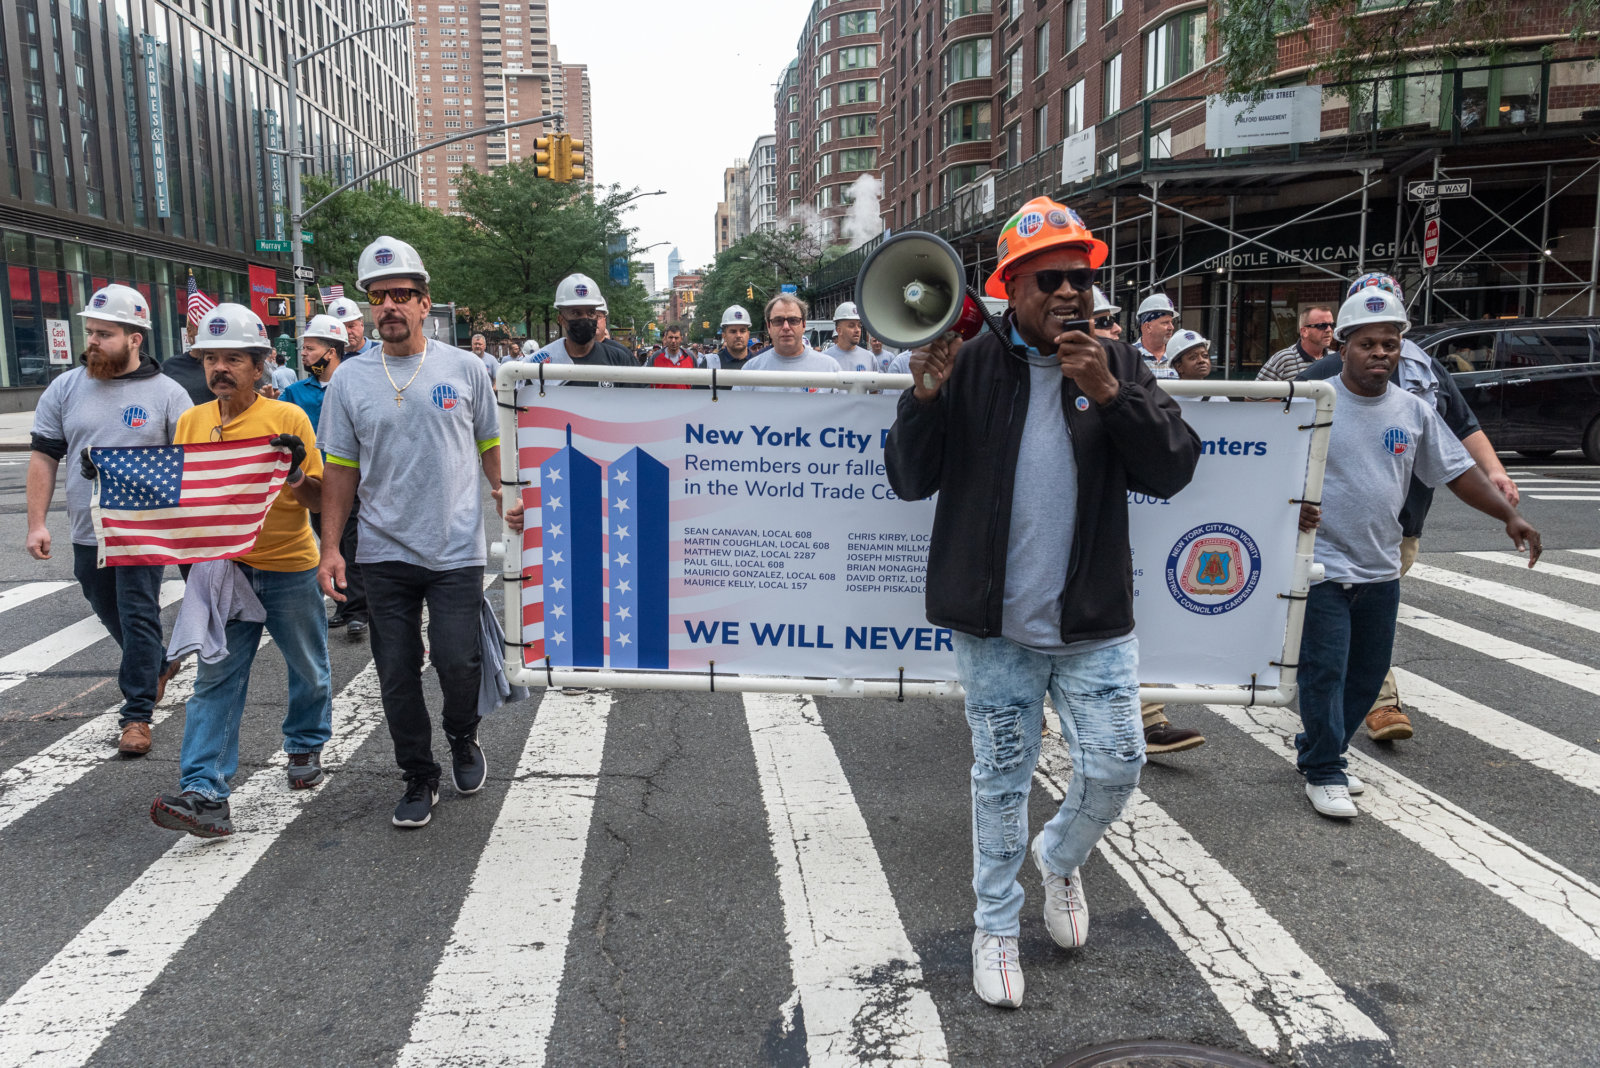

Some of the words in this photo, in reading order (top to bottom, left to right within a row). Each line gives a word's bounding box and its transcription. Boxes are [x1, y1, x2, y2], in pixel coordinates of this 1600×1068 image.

[1276, 90, 1295, 99] STREET
[1416, 186, 1436, 195] ONE
[1444, 184, 1465, 193] WAY
[260, 241, 281, 251] Murray
[1276, 244, 1362, 264] MEXICAN
[52, 328, 65, 337] Cash
[53, 338, 66, 347] Back
[685, 423, 744, 445] New
[750, 425, 811, 448] York
[819, 427, 872, 454] City
[1200, 436, 1268, 456] nters
[685, 454, 801, 474] Remembers
[807, 461, 840, 475] our
[845, 458, 886, 476] falle
[684, 478, 701, 495] in
[707, 479, 739, 496] the
[745, 480, 804, 498] World
[810, 482, 865, 500] Trade
[684, 527, 709, 536] SEAN
[711, 528, 760, 538] CANAVAN,
[762, 529, 793, 539] LOCAL
[795, 531, 812, 539] 608
[847, 532, 877, 541] CHRIS
[879, 533, 908, 542] KIRBY,
[910, 534, 932, 542] LOC
[684, 538, 720, 546] MARTIN
[722, 538, 778, 549] COUGHLAN,
[780, 540, 811, 550] LOCAL
[812, 542, 830, 550] 608
[1171, 540, 1185, 558] NEW
[1183, 526, 1205, 542] YORK
[1205, 524, 1224, 532] CITY
[1224, 525, 1240, 536] AND
[1240, 532, 1260, 559] VICINITY
[847, 543, 894, 552] BENJAMIN
[896, 544, 931, 552] MILLMA
[684, 548, 731, 557] MATTHEW
[734, 550, 759, 559] DIAZ,
[761, 551, 791, 559] LOCAL
[793, 552, 816, 560] 2287
[846, 553, 883, 562] JOSEPH
[684, 558, 708, 566] PAUL
[710, 559, 733, 568] GILL,
[735, 560, 765, 568] LOCAL
[767, 561, 785, 569] 608
[846, 563, 876, 572] BRIAN
[878, 564, 927, 573] MONAGHA
[684, 569, 730, 577] MAURICIO
[732, 570, 784, 580] GONZALEZ,
[786, 571, 817, 580] LOCAL
[818, 573, 836, 581] 608
[846, 574, 876, 582] DAVID
[878, 575, 908, 584] ORTIZ,
[684, 579, 726, 587] MAURICE
[728, 580, 756, 589] KELLY,
[758, 581, 789, 590] LOCAL
[791, 582, 808, 590] 157
[845, 584, 881, 592] JOSEPH
[1167, 568, 1183, 599] DISTRICT
[1180, 598, 1212, 614] COUNCIL
[1224, 570, 1260, 610] CARPENTERS
[684, 619, 740, 645] WE
[749, 622, 834, 649] WILL
[845, 626, 954, 652] NEVER
